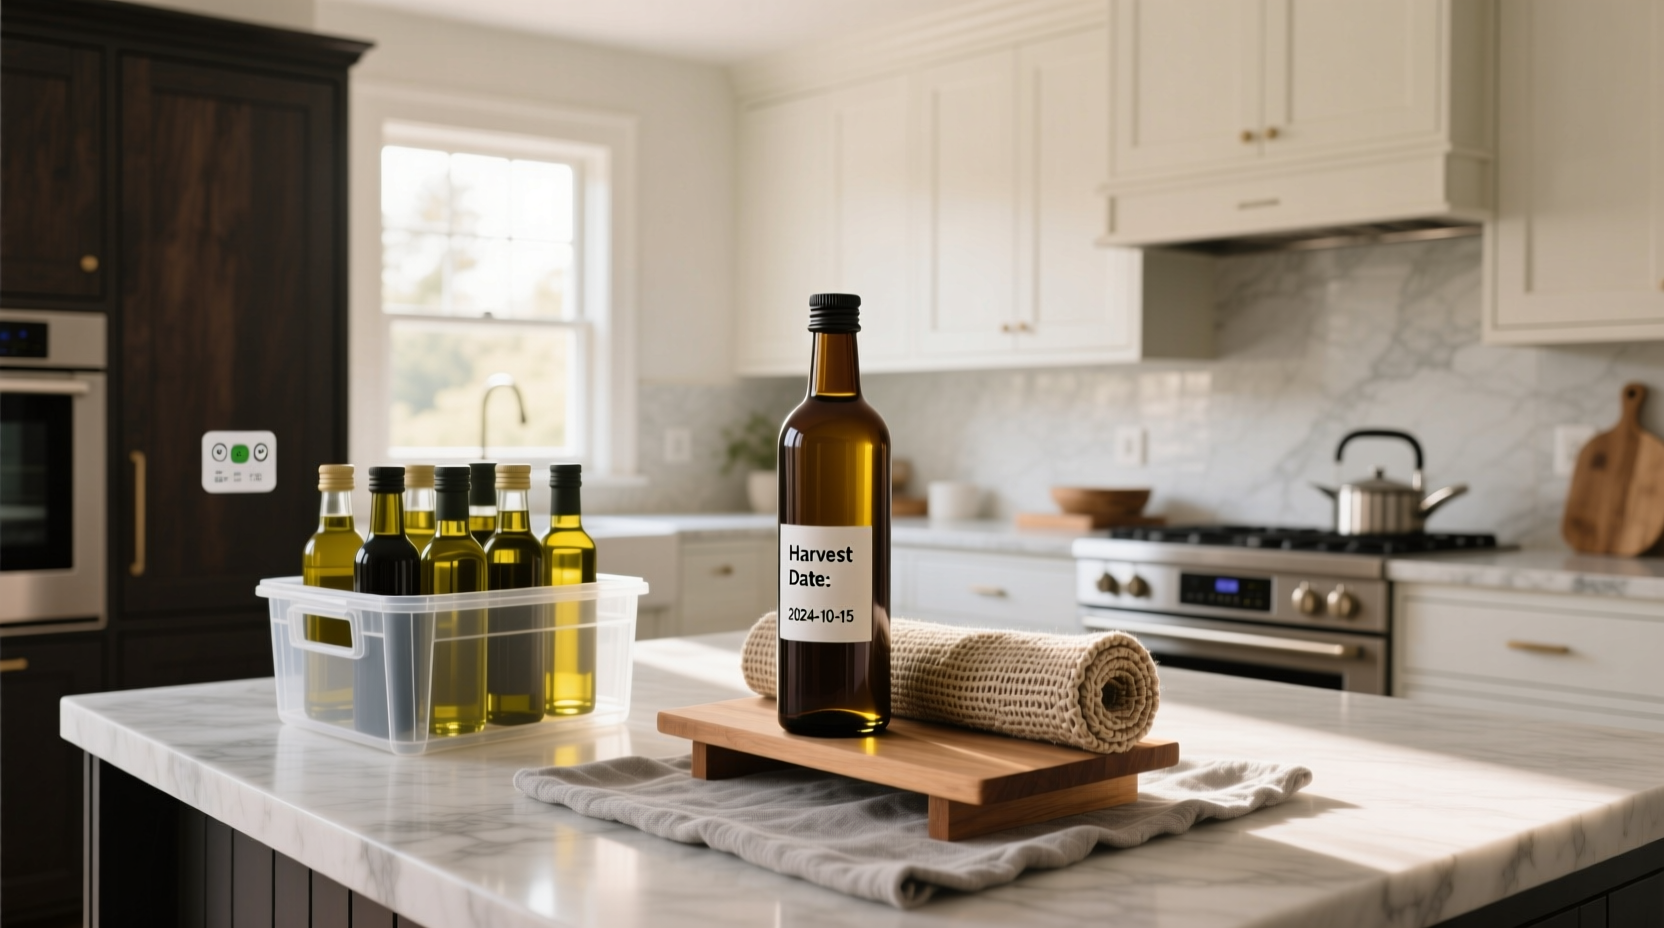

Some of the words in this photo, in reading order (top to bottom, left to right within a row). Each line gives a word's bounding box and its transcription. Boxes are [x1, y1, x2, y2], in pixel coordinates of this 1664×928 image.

[789, 544, 854, 563] Harvest
[789, 569, 831, 588] Date:
[788, 607, 854, 623] 2024-10-15
